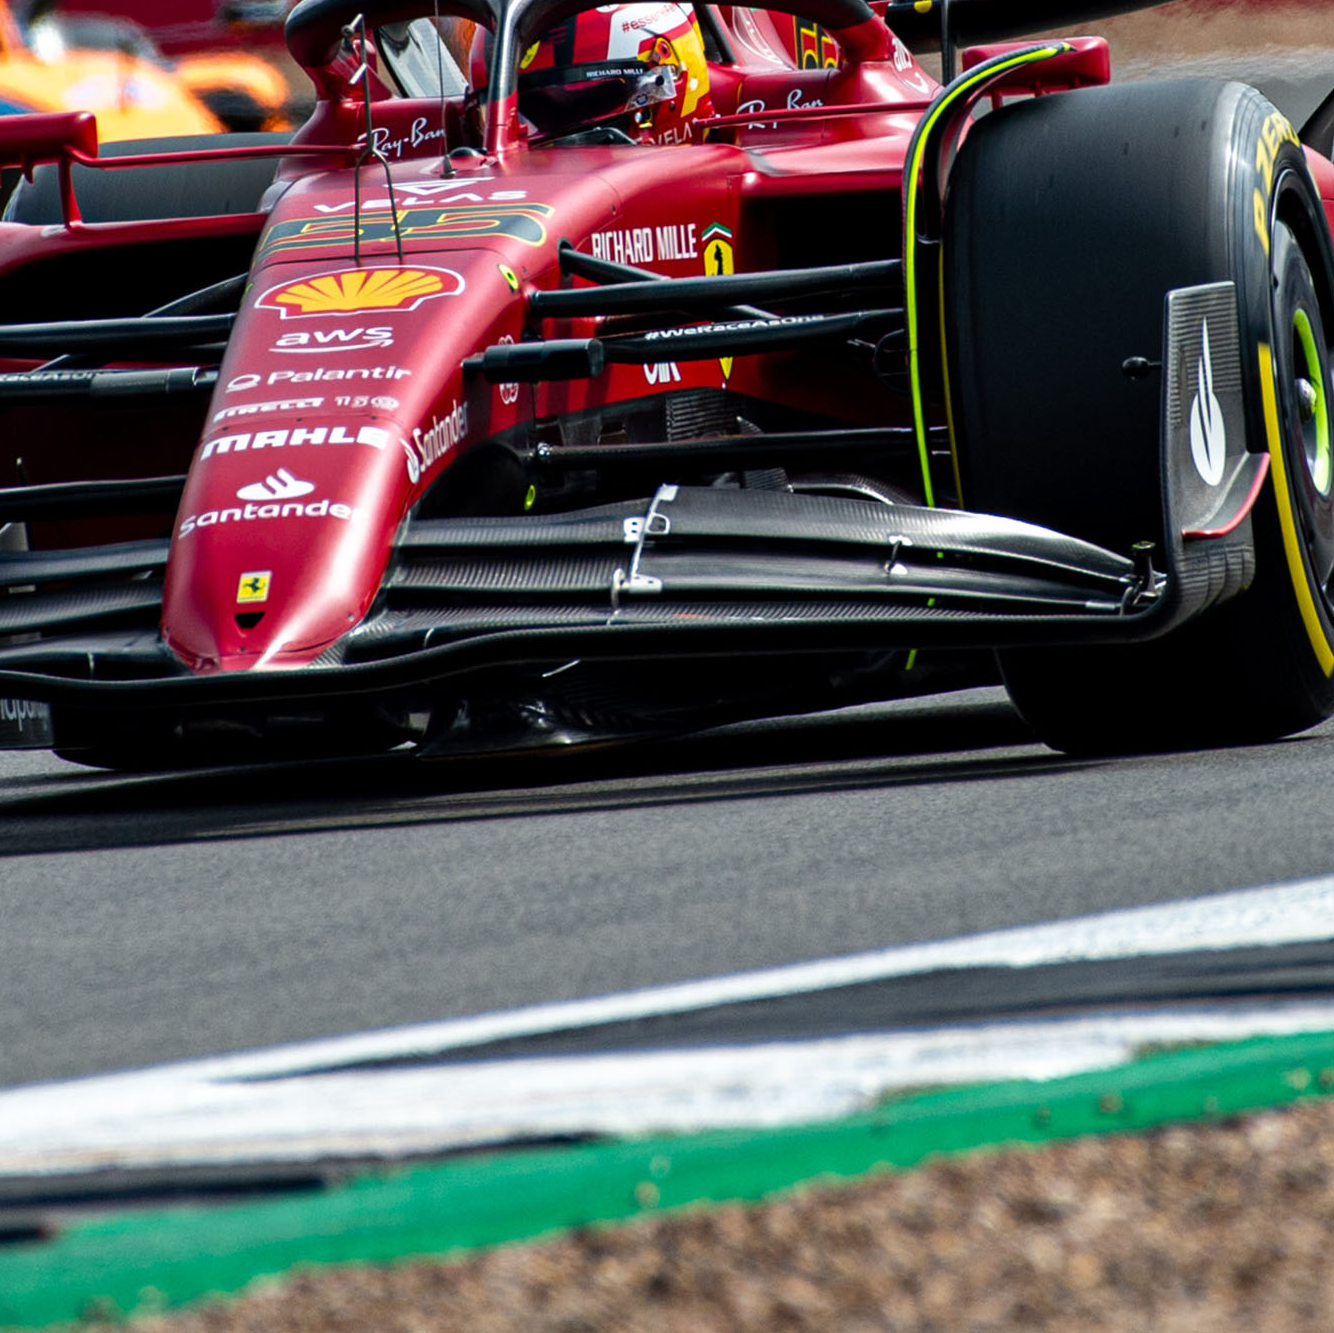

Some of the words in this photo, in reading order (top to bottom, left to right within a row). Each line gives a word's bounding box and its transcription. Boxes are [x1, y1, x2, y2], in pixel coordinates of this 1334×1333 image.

[586, 68, 622, 78] RICHARD
[623, 67, 644, 76] MILLE
[357, 117, 446, 157] Ray-Ban
[313, 190, 528, 213] VELAS
[255, 202, 555, 266] 55
[591, 227, 654, 264] RICHARD
[656, 223, 698, 261] MILLE
[276, 326, 394, 347] aws
[644, 314, 825, 340] #WeRaceAsOne
[267, 366, 412, 385] Palantir
[200, 426, 390, 461] MAHLE
